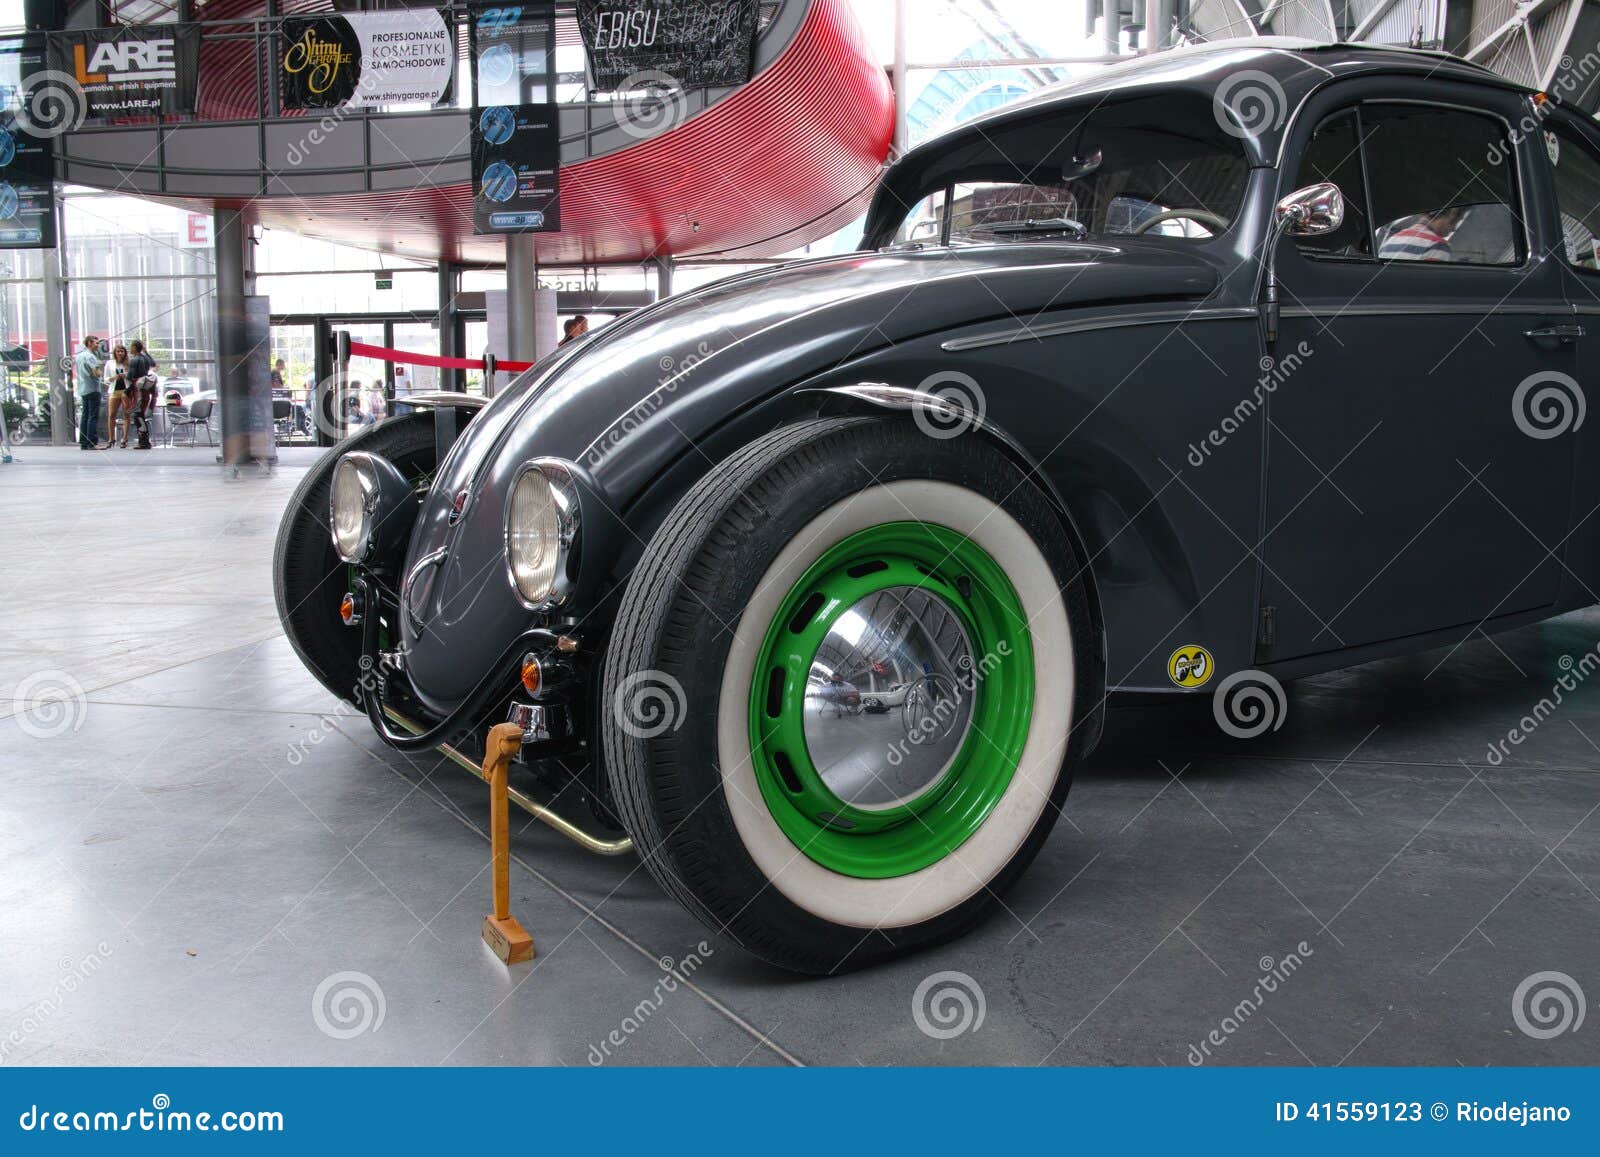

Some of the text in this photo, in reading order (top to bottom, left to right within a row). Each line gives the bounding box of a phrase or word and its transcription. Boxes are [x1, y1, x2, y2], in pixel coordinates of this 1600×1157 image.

[372, 30, 446, 43] PROFESJONALNE
[594, 9, 660, 50] EBISU
[372, 42, 446, 58] KOSMETYKI
[74, 38, 176, 84] LARE
[285, 28, 343, 94] Shiny
[309, 53, 353, 66] GARAGE
[371, 57, 447, 70] SAMOCHODOWE
[362, 89, 440, 101] www.shinygarage.pl
[91, 99, 161, 110] www.LARE.pl
[187, 214, 208, 243] E
